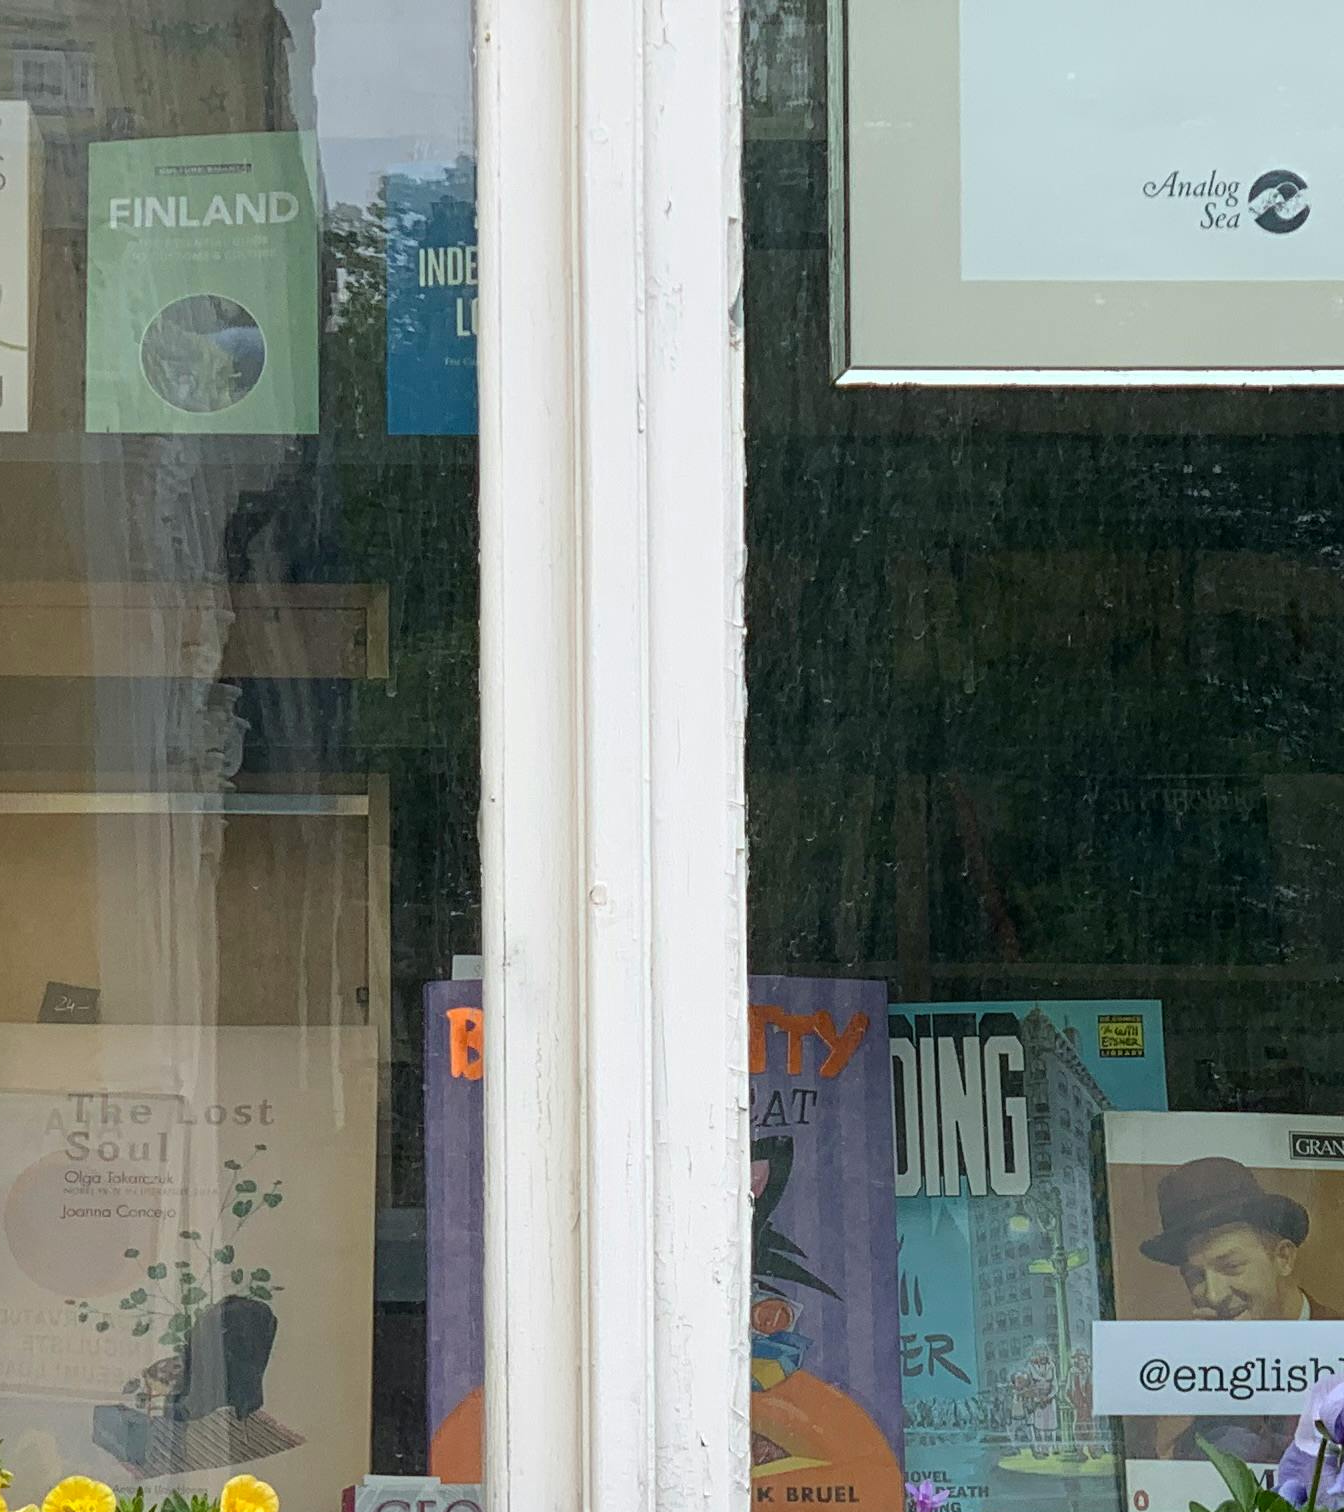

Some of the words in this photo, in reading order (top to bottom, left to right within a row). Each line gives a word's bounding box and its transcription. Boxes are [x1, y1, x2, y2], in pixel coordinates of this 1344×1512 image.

[109, 191, 301, 231] FINLAND
[1143, 170, 1241, 207] Analog
[1199, 203, 1241, 230] Sea
[67, 1092, 153, 1125] The
[175, 1098, 275, 1126] Lost
[64, 1131, 169, 1163] Soul
[64, 1170, 102, 1187] Olga
[59, 1203, 112, 1219] Joanna
[785, 1486, 861, 1505] BRUEL
